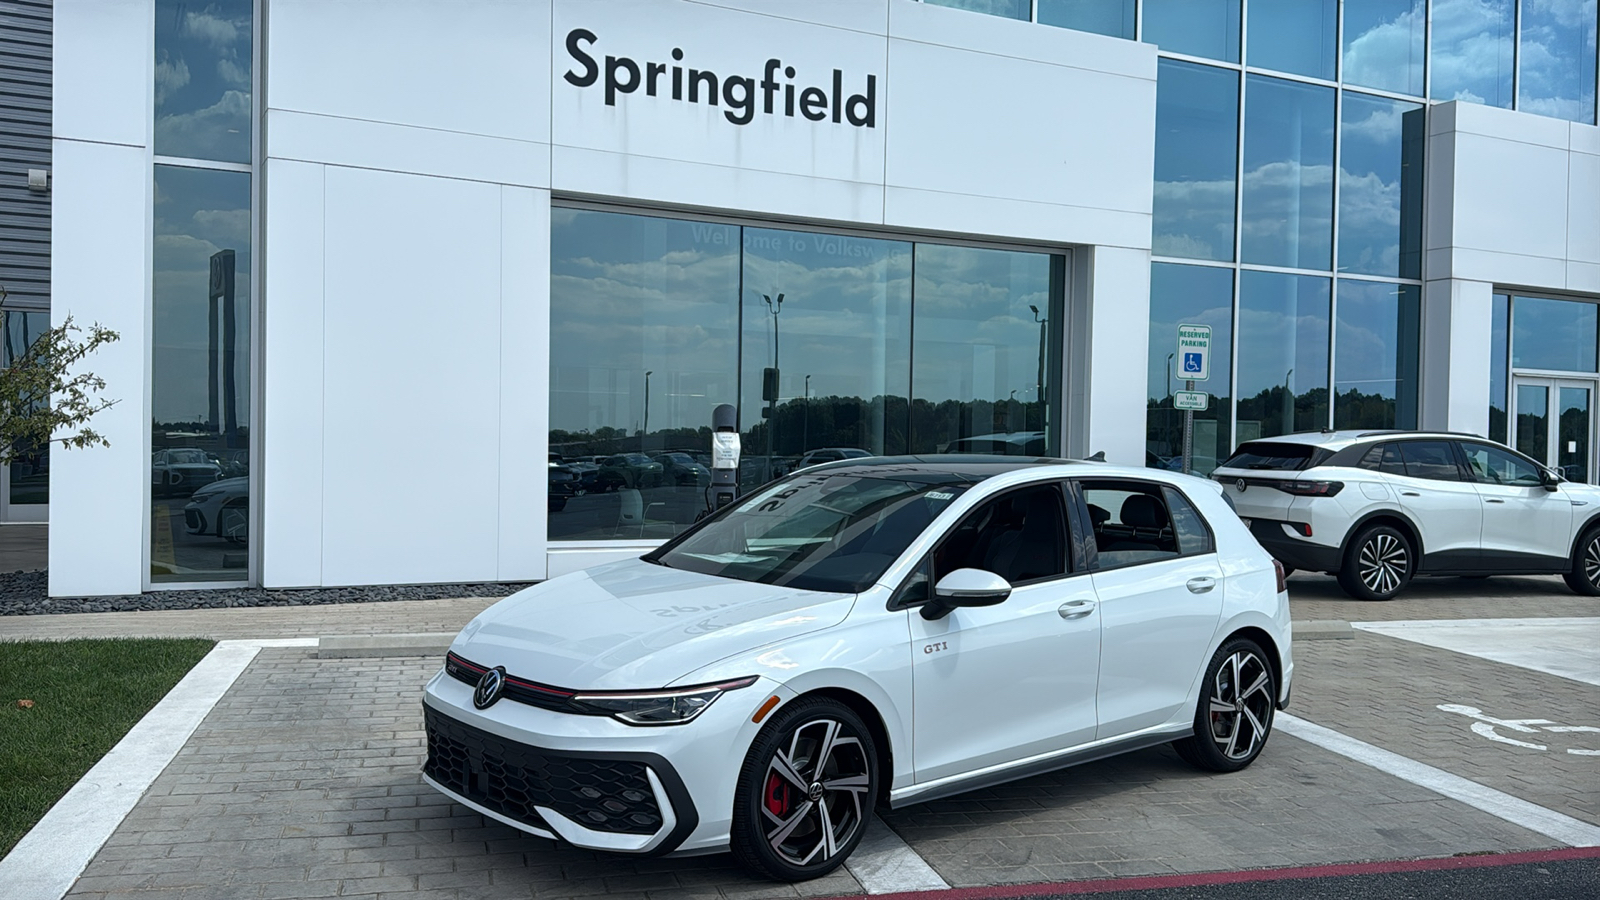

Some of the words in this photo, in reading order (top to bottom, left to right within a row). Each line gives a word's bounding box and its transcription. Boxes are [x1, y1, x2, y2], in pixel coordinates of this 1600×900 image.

[563, 28, 876, 128] Springfield
[788, 236, 806, 252] to
[1180, 331, 1209, 339] RESERVED
[1181, 340, 1207, 348] PARKING
[924, 641, 948, 654] GTI
